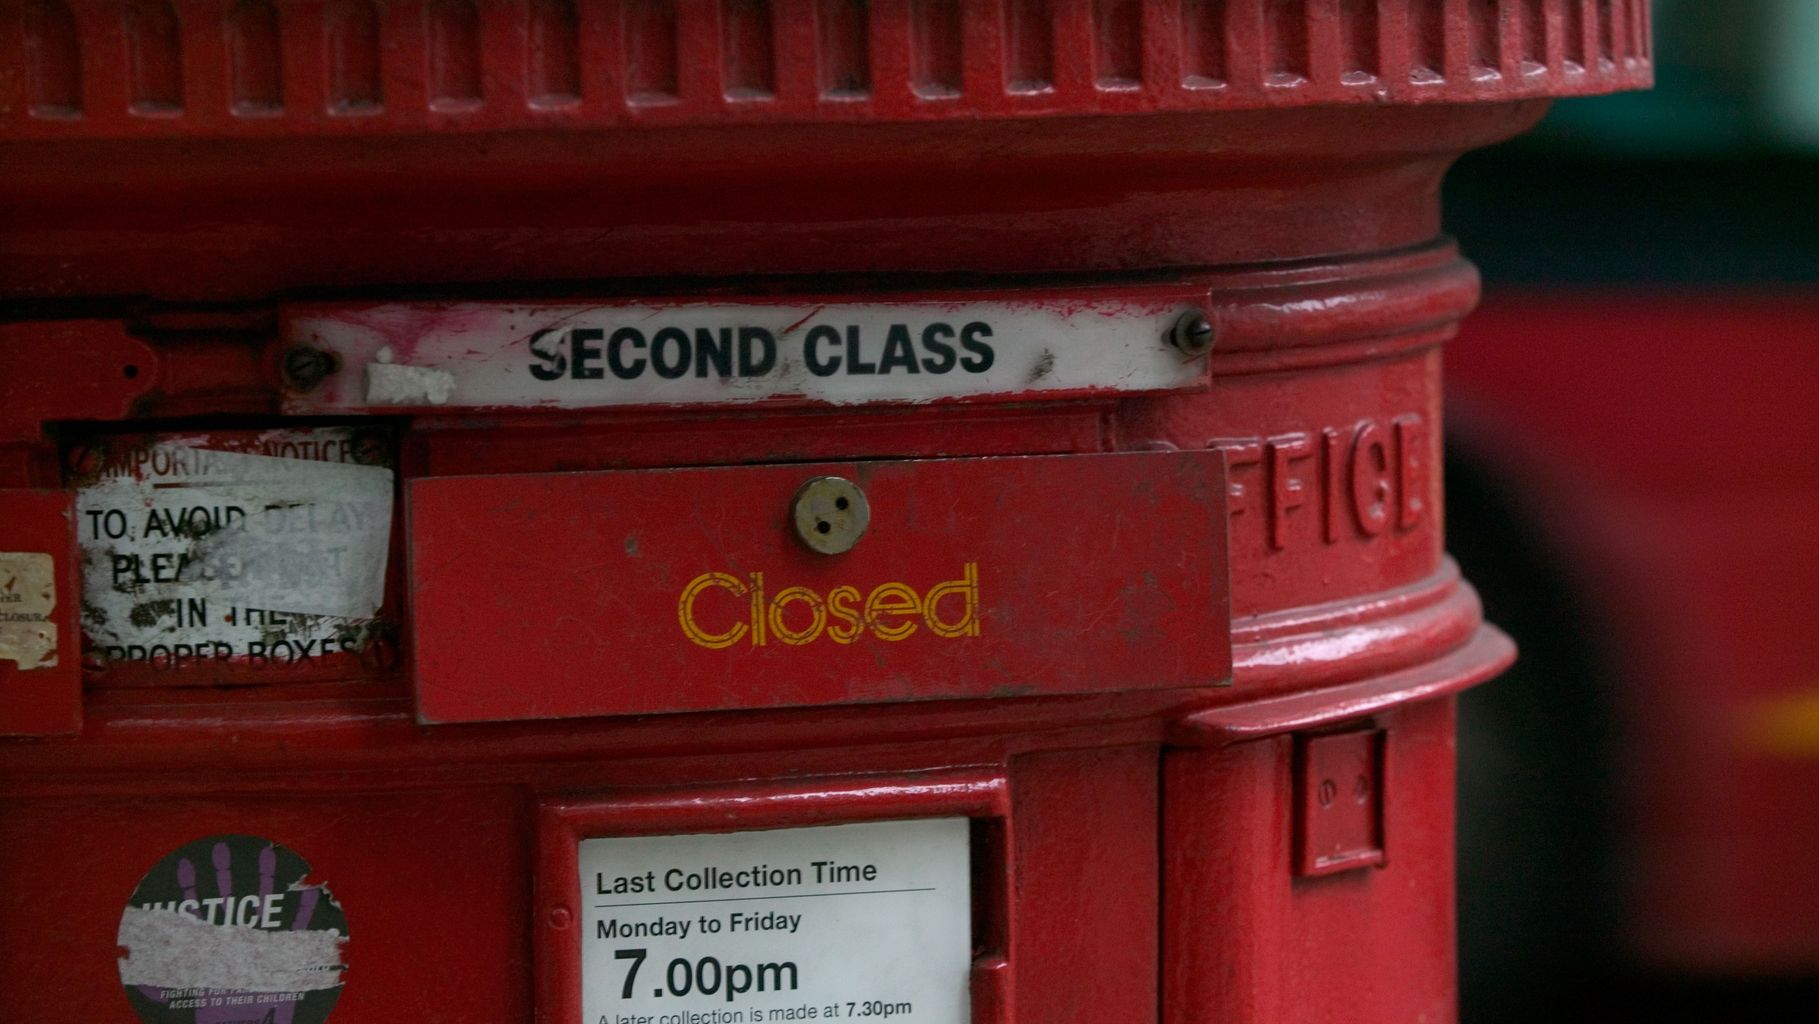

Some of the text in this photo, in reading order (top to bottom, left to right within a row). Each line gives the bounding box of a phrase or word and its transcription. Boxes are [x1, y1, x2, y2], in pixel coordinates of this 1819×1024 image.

[528, 321, 995, 380] SECOND CLASS
[1207, 413, 1422, 553] FFICE
[86, 509, 127, 540] TO
[176, 598, 207, 628] IN
[678, 562, 980, 649] Closed
[247, 637, 359, 666] BOXES
[596, 861, 878, 895] Last Collection Time
[596, 912, 802, 939] Monday to Friday
[614, 948, 799, 1002] 7.00pm
[169, 992, 305, 1009] ACCESS TO THEIR CHILDREN
[599, 999, 913, 1024] A later collection is made at 7.30pm
